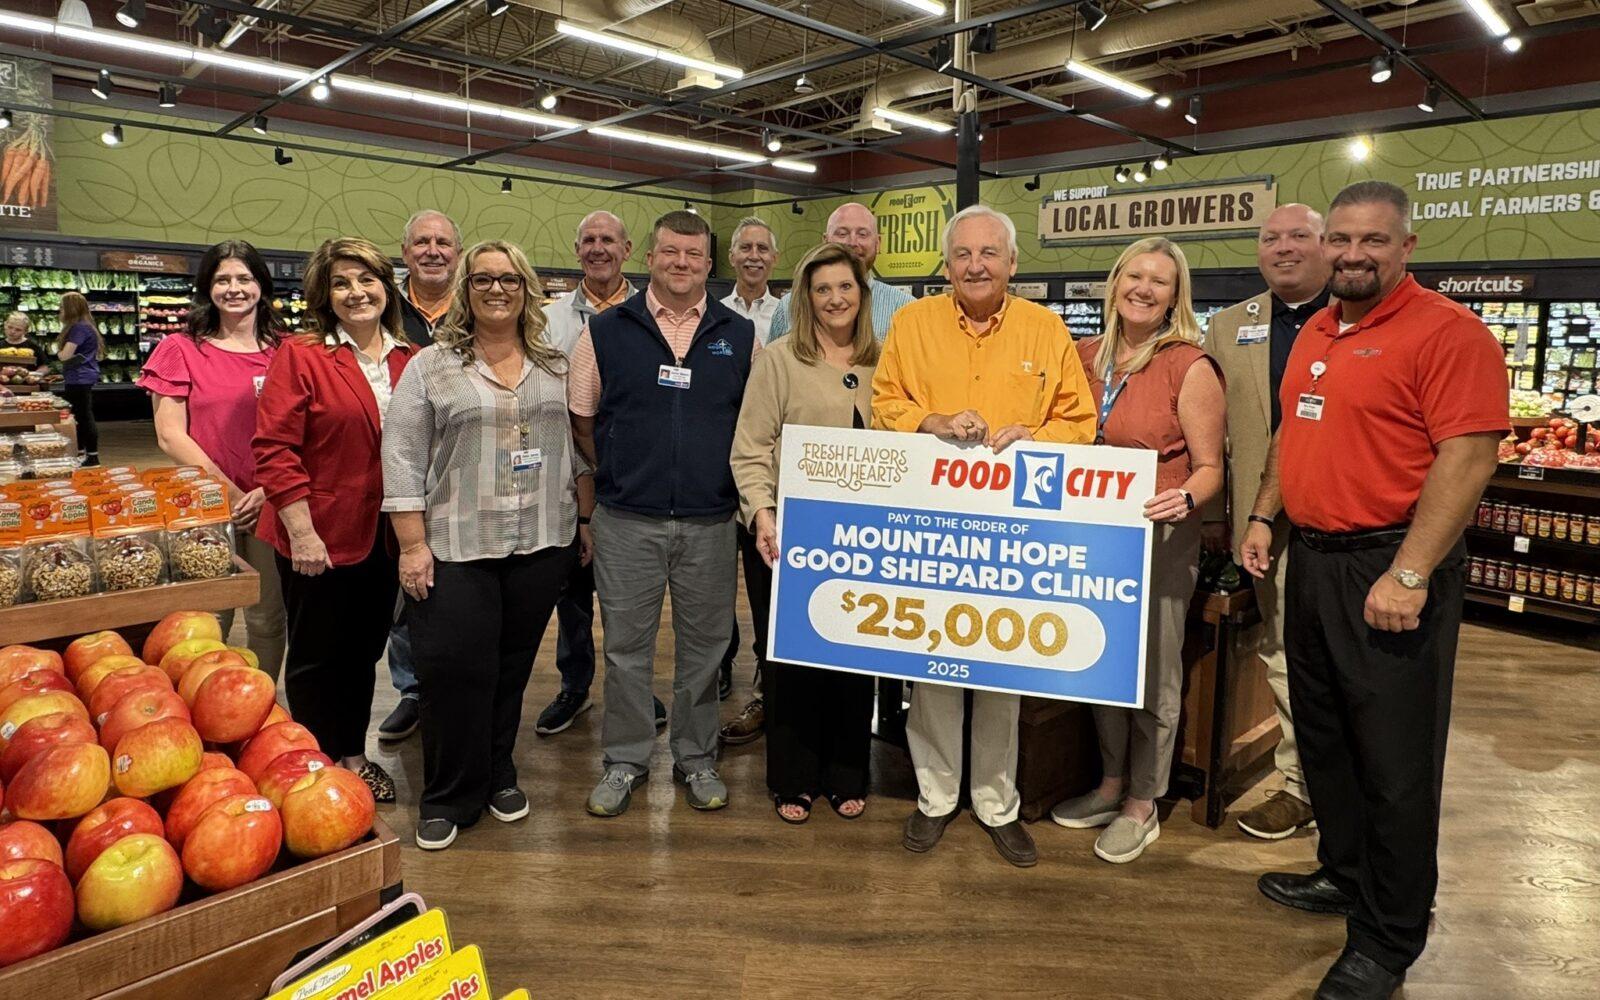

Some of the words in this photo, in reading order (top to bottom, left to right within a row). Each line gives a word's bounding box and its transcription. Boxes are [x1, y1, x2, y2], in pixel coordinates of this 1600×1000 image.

[1415, 171, 1463, 191] TRUE
[1468, 160, 1600, 187] PARTNERSHI
[1053, 188, 1068, 201] WE
[1069, 185, 1109, 200] SUPPORT
[1412, 201, 1473, 220] LOCAL
[1480, 194, 1582, 216] FARMERS
[1052, 203, 1120, 233] LOCAL
[1128, 191, 1254, 229] GROWERS
[877, 210, 939, 255] FRESH
[1437, 276, 1524, 293] shortcuts
[802, 442, 844, 461] FRESH
[846, 446, 908, 473] FLAVORS
[798, 458, 847, 479] WARM
[840, 463, 902, 490] HEARTS
[931, 458, 1011, 491] FOOD
[1066, 468, 1137, 500] CITY
[0, 510, 20, 519] andy
[61, 502, 88, 512] Candy
[887, 512, 911, 524] PAY
[914, 514, 932, 527] TO
[934, 516, 959, 529] THE
[961, 519, 1008, 534] ORDER
[1010, 523, 1030, 535] OF
[832, 523, 992, 561] MOUNTAIN
[999, 539, 1088, 570] HOPE
[786, 546, 874, 576] GOOD
[879, 555, 1025, 592] SHEPARD
[1030, 570, 1139, 604] CLINIC
[841, 590, 1068, 657] $25,000
[927, 660, 970, 679] 2025
[379, 938, 443, 988] Apples
